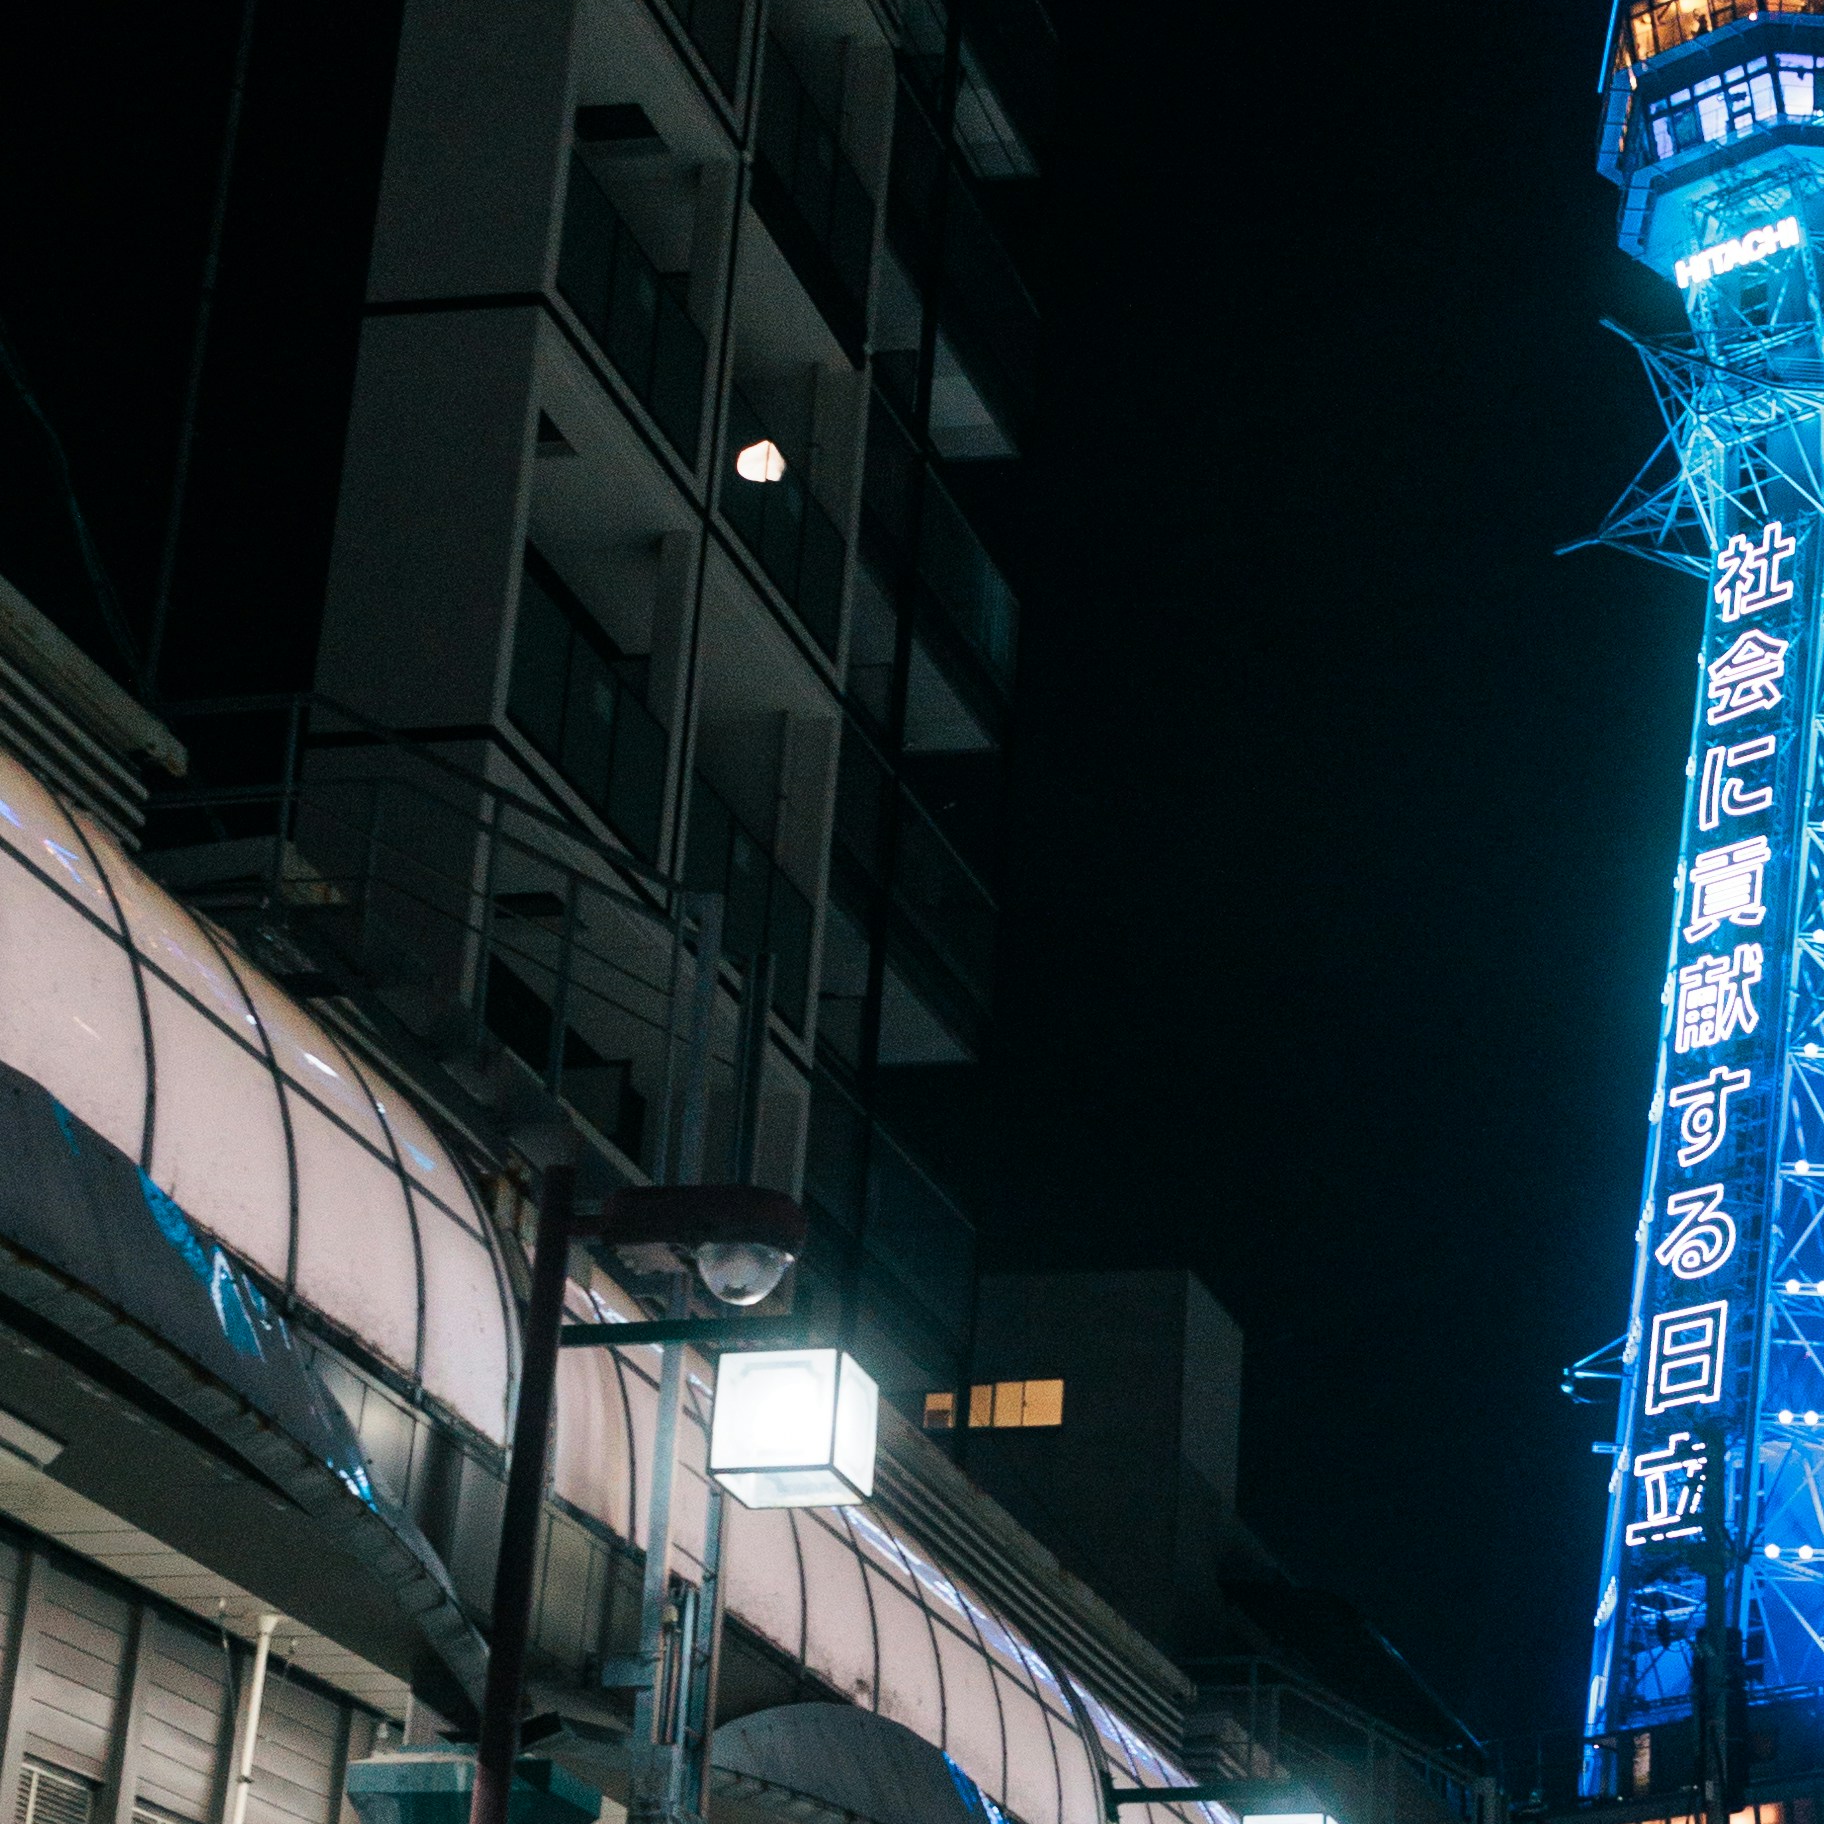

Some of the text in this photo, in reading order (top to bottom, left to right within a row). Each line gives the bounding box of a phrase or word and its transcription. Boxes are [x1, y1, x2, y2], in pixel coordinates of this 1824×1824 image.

[1676, 218, 1798, 287] HITACHI
[1626, 521, 1796, 1545] 社会に貢献する日立
